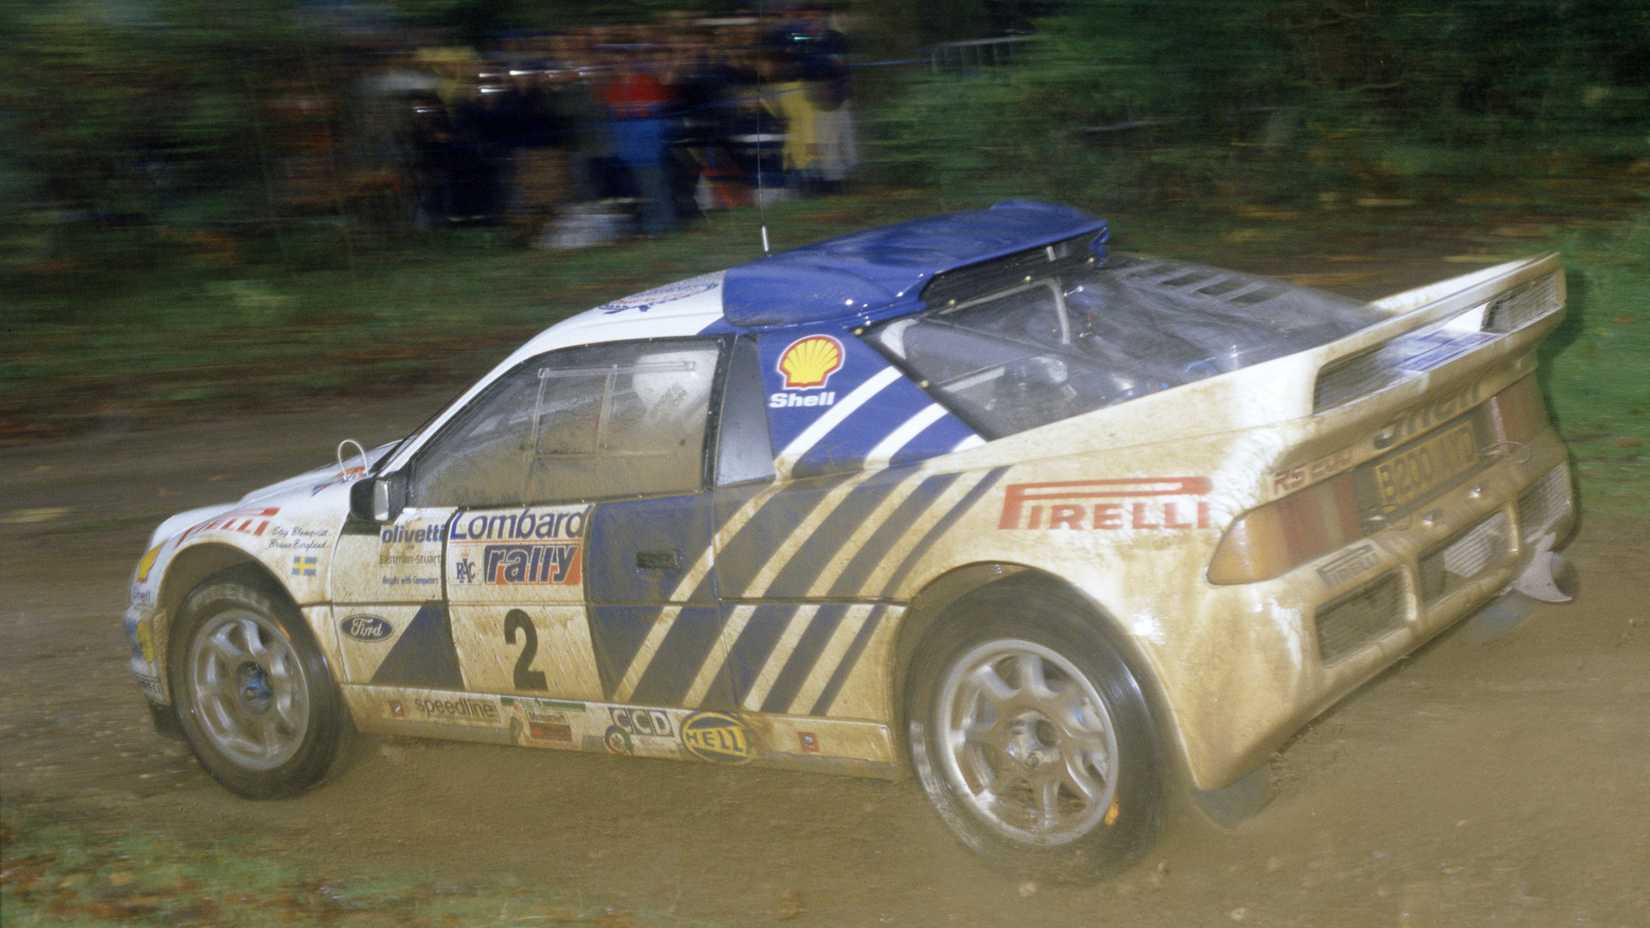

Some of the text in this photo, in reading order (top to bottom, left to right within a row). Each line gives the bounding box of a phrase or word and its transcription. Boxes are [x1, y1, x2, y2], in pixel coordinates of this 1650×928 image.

[768, 391, 835, 408] Shell
[997, 476, 1214, 530] PIRELLI
[382, 523, 447, 544] olivetti
[450, 504, 592, 540] Lombard
[486, 545, 578, 584] rally
[349, 616, 385, 638] Ford
[504, 608, 548, 690] 2
[414, 698, 498, 719] speedline
[613, 709, 671, 735] CCD
